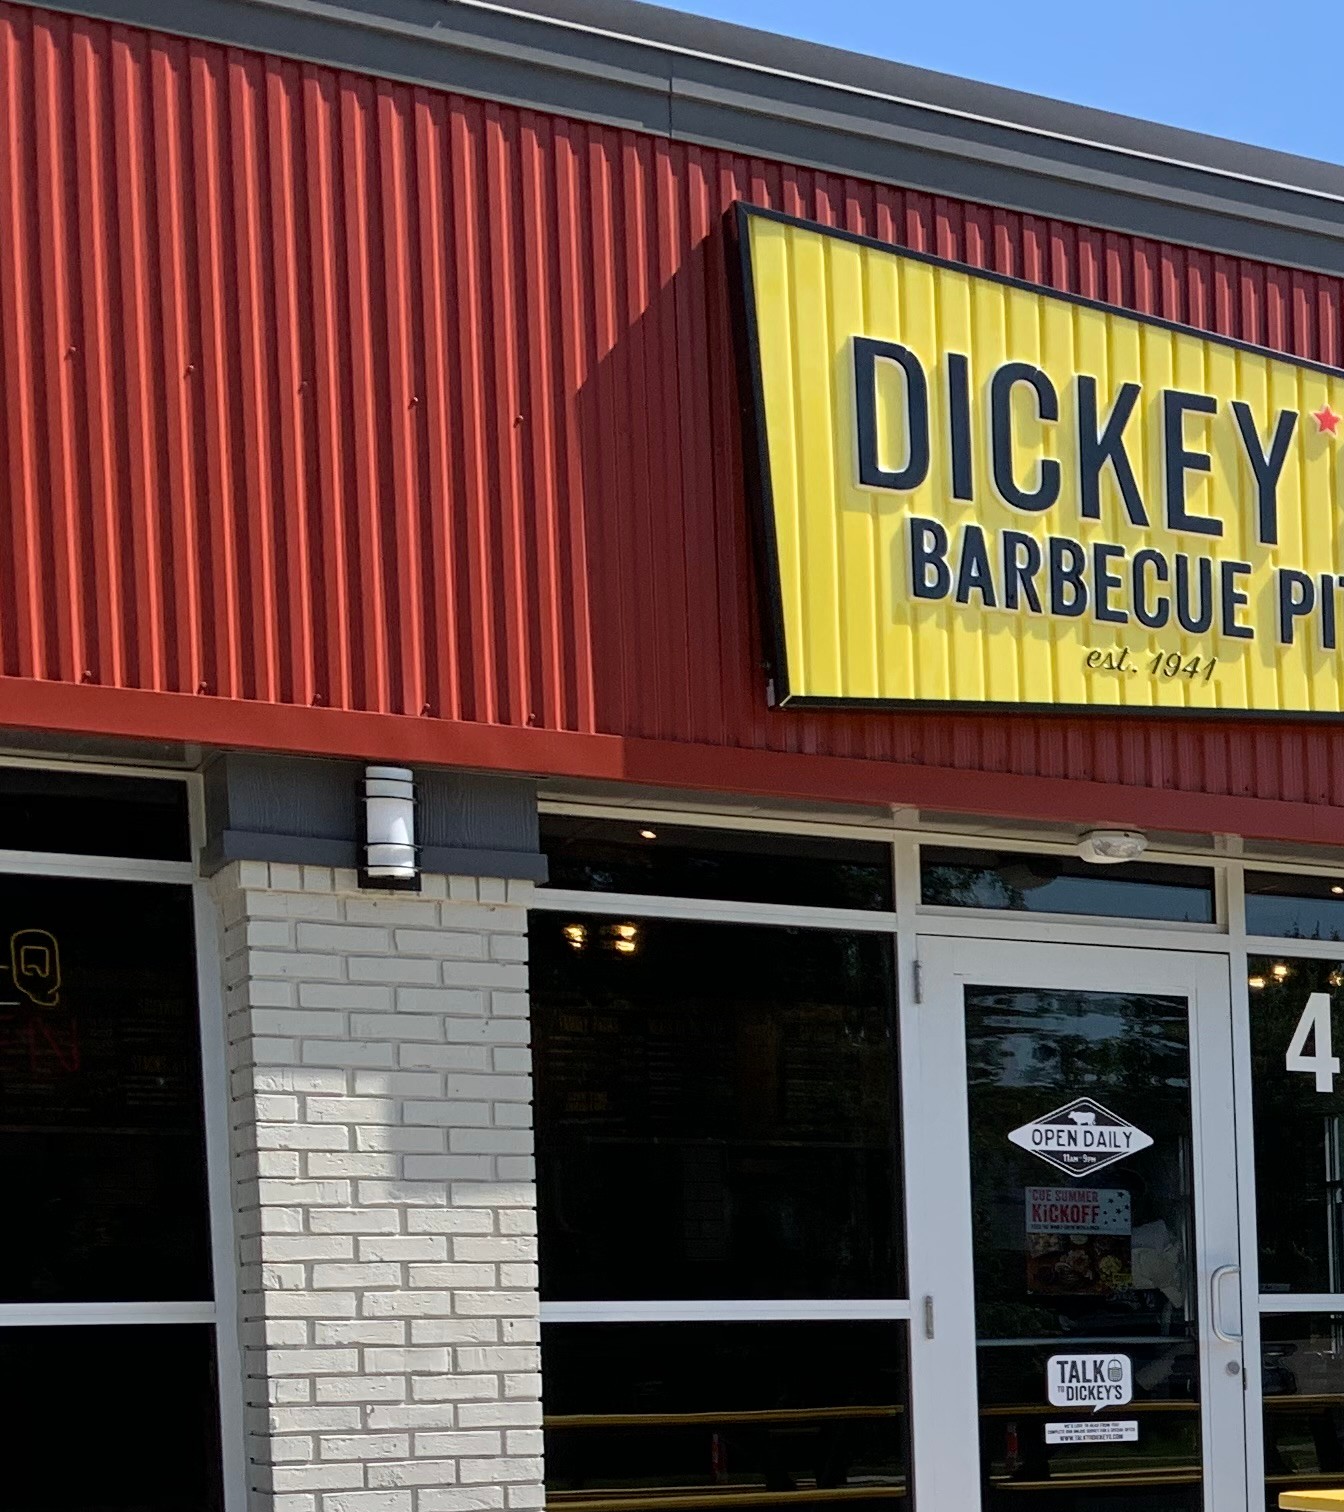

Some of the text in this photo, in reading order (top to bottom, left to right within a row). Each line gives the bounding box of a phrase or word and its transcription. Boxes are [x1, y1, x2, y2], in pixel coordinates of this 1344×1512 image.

[910, 517, 1255, 641] BARBECUE
[1086, 647, 1218, 681] est. 1941
[1031, 1128, 1133, 1149] OPEN DAILY
[1055, 1189, 1099, 1203] SUMMER
[1056, 1360, 1106, 1383] TALK
[1066, 1385, 1122, 1401] DICKEY'S
